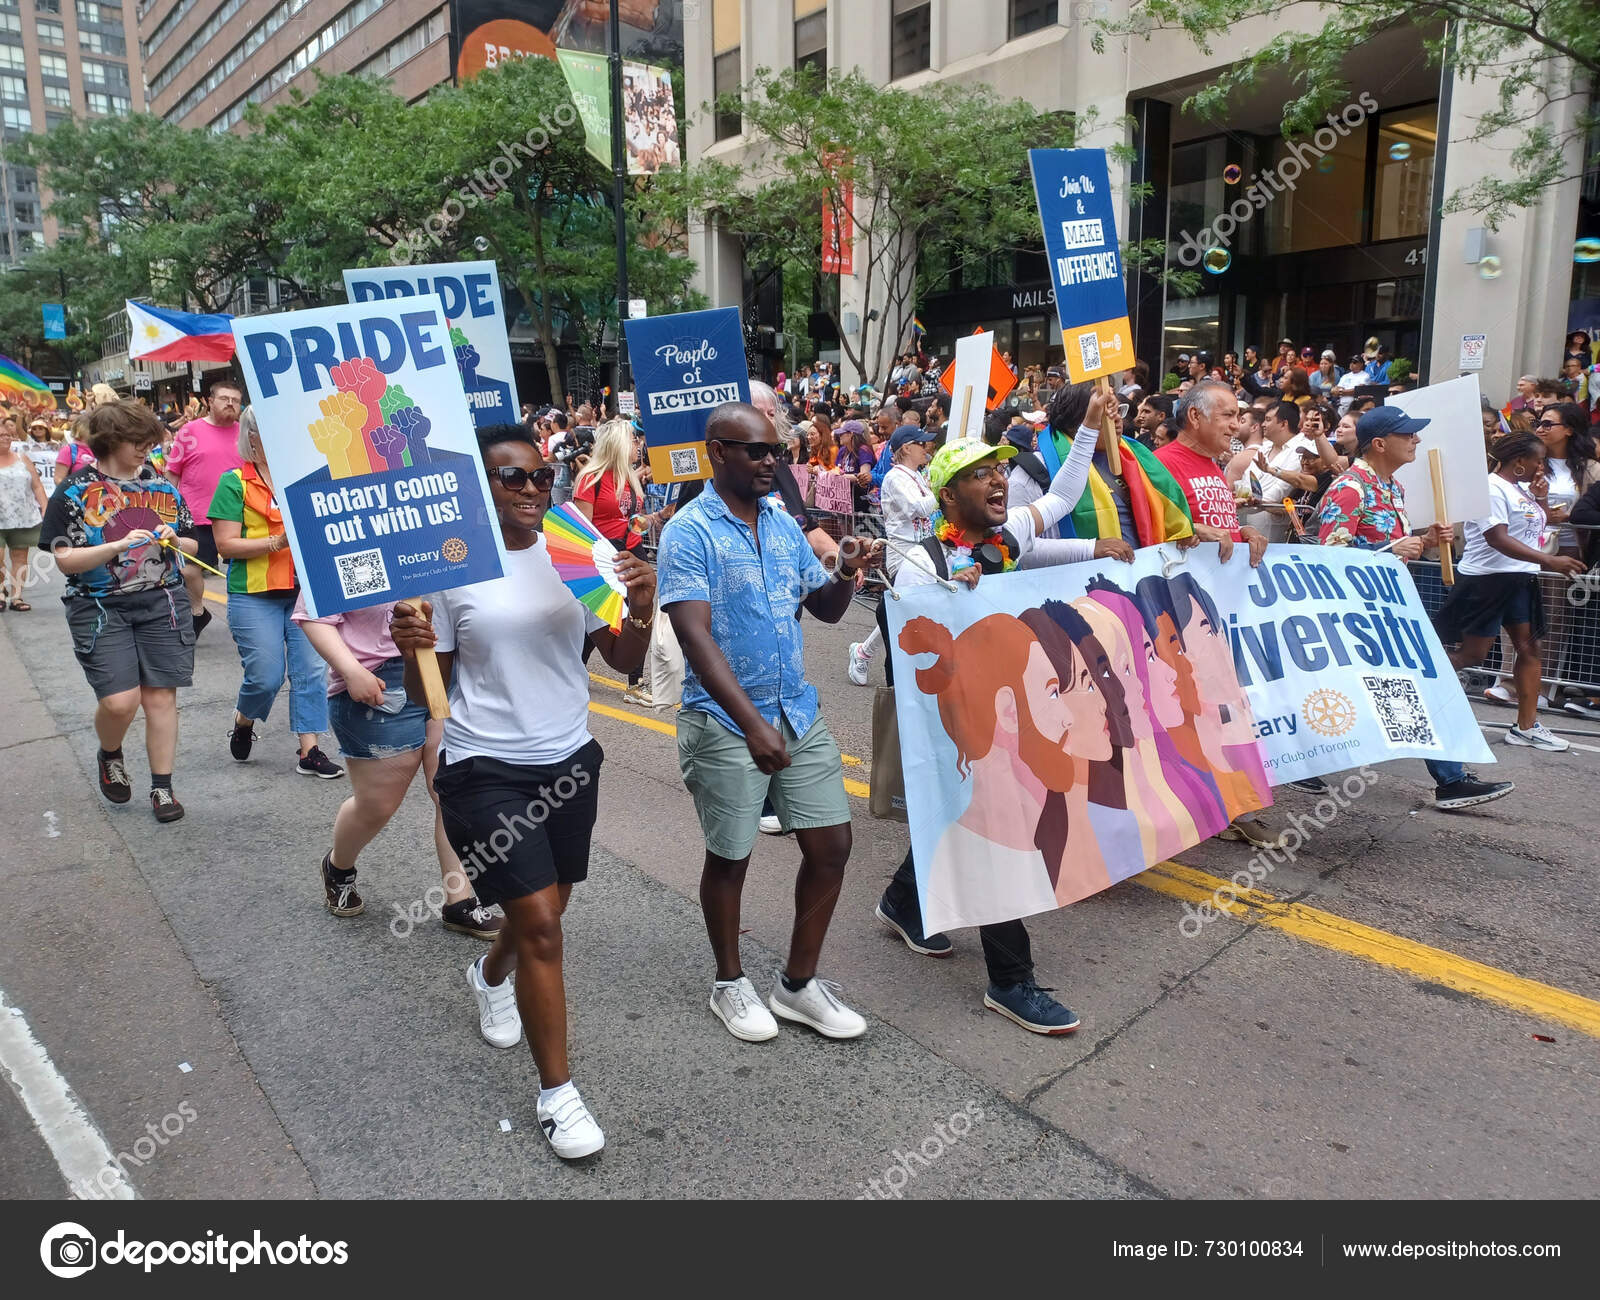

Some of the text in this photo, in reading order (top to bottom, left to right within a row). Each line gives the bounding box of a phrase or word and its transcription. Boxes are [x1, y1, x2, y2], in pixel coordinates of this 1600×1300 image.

[1059, 175, 1080, 199] Join
[1076, 199, 1086, 215] &
[1065, 223, 1103, 245] MAKE
[1057, 251, 1119, 287] DIFFERENCE!
[1012, 289, 1056, 309] NAILS
[244, 310, 447, 399] PRIDE
[655, 339, 718, 368] People
[136, 378, 150, 388] 40
[682, 367, 703, 385] of
[465, 390, 503, 409] PRIDE
[653, 387, 738, 411] ACTION!
[310, 471, 459, 518] Rotary come
[324, 496, 463, 545] out with us!
[397, 550, 440, 567] Rotary
[1248, 554, 1407, 608] Join our
[1221, 602, 1438, 688] iversity
[1281, 751, 1306, 765] Club
[1307, 747, 1319, 759] of
[1320, 739, 1361, 756] Toronto
